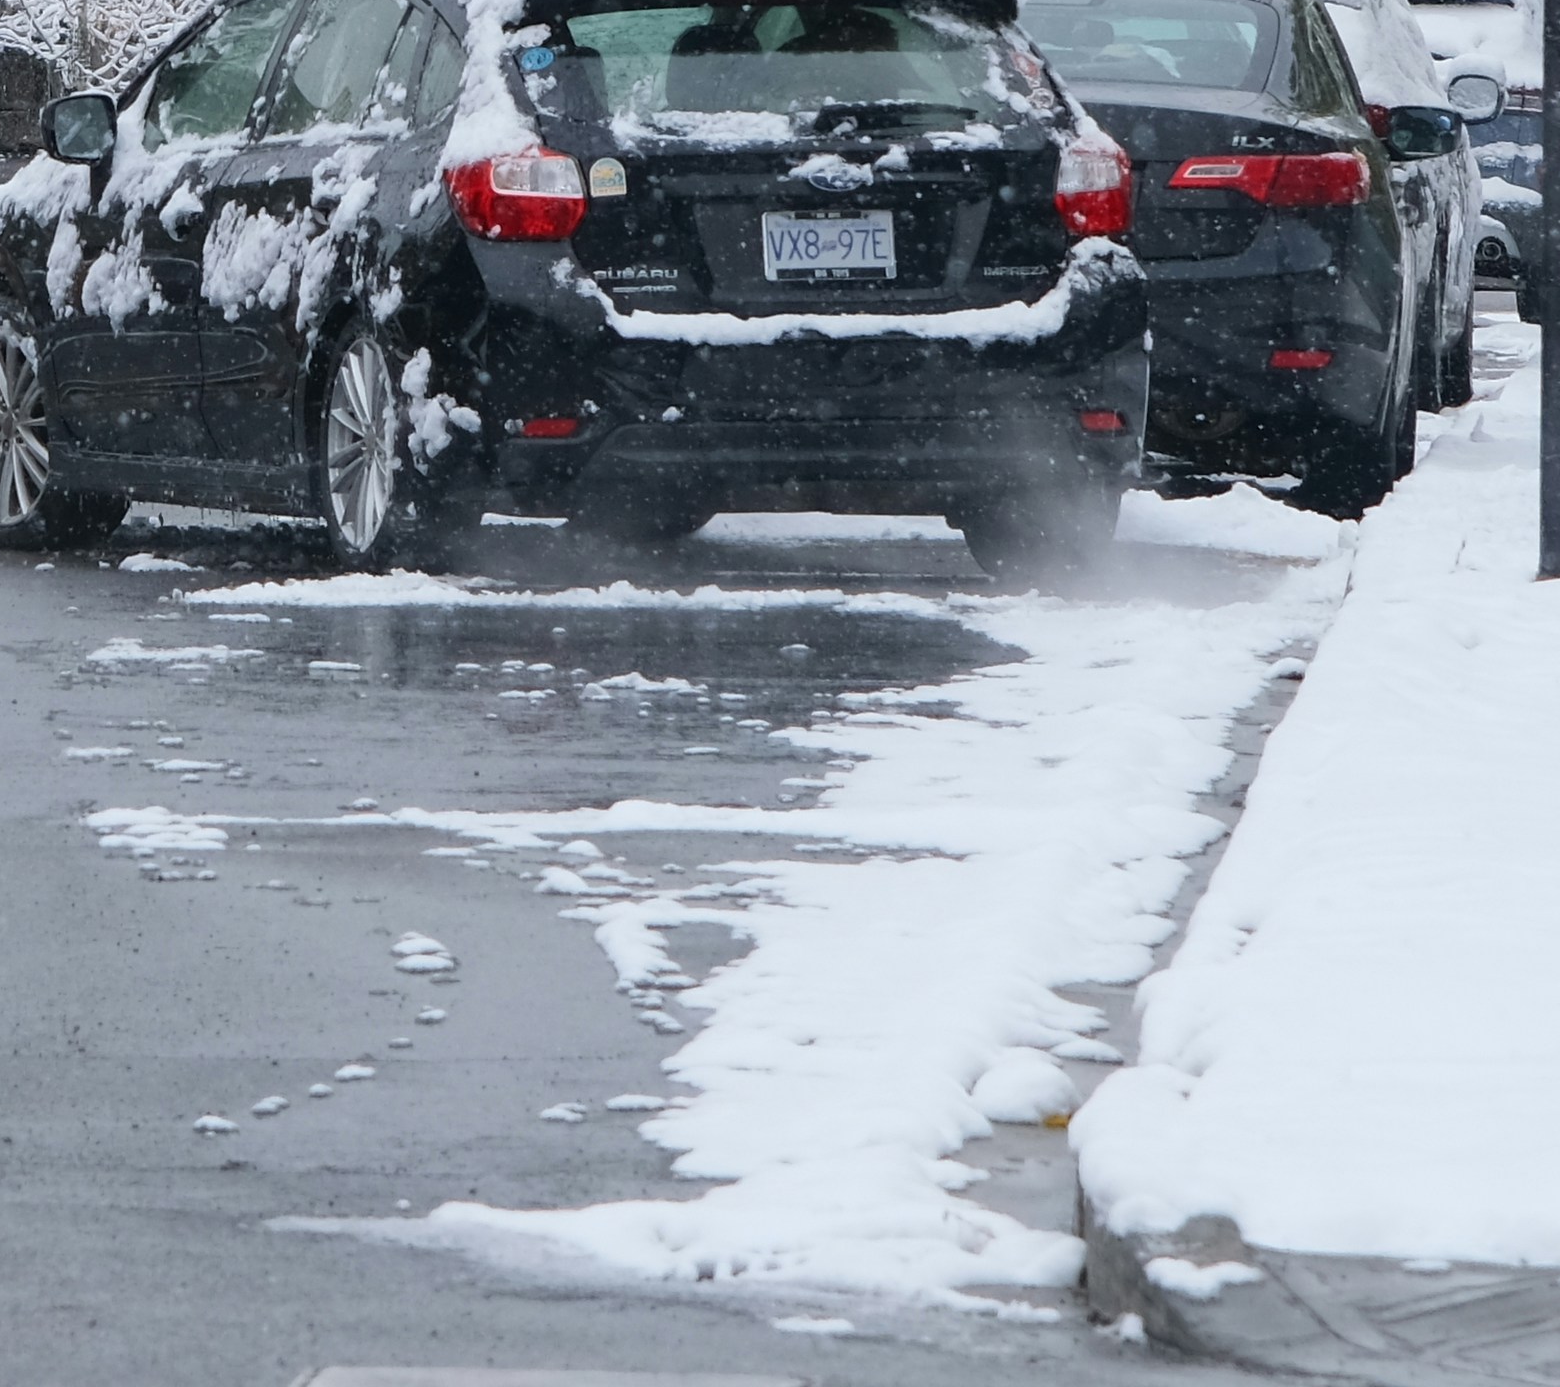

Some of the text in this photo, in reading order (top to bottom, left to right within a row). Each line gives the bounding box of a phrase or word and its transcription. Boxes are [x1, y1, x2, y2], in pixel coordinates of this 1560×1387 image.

[1231, 136, 1275, 148] ILX
[769, 229, 888, 261] VX8 97E
[593, 266, 679, 280] SUBARU
[983, 265, 1049, 277] IMPREZA
